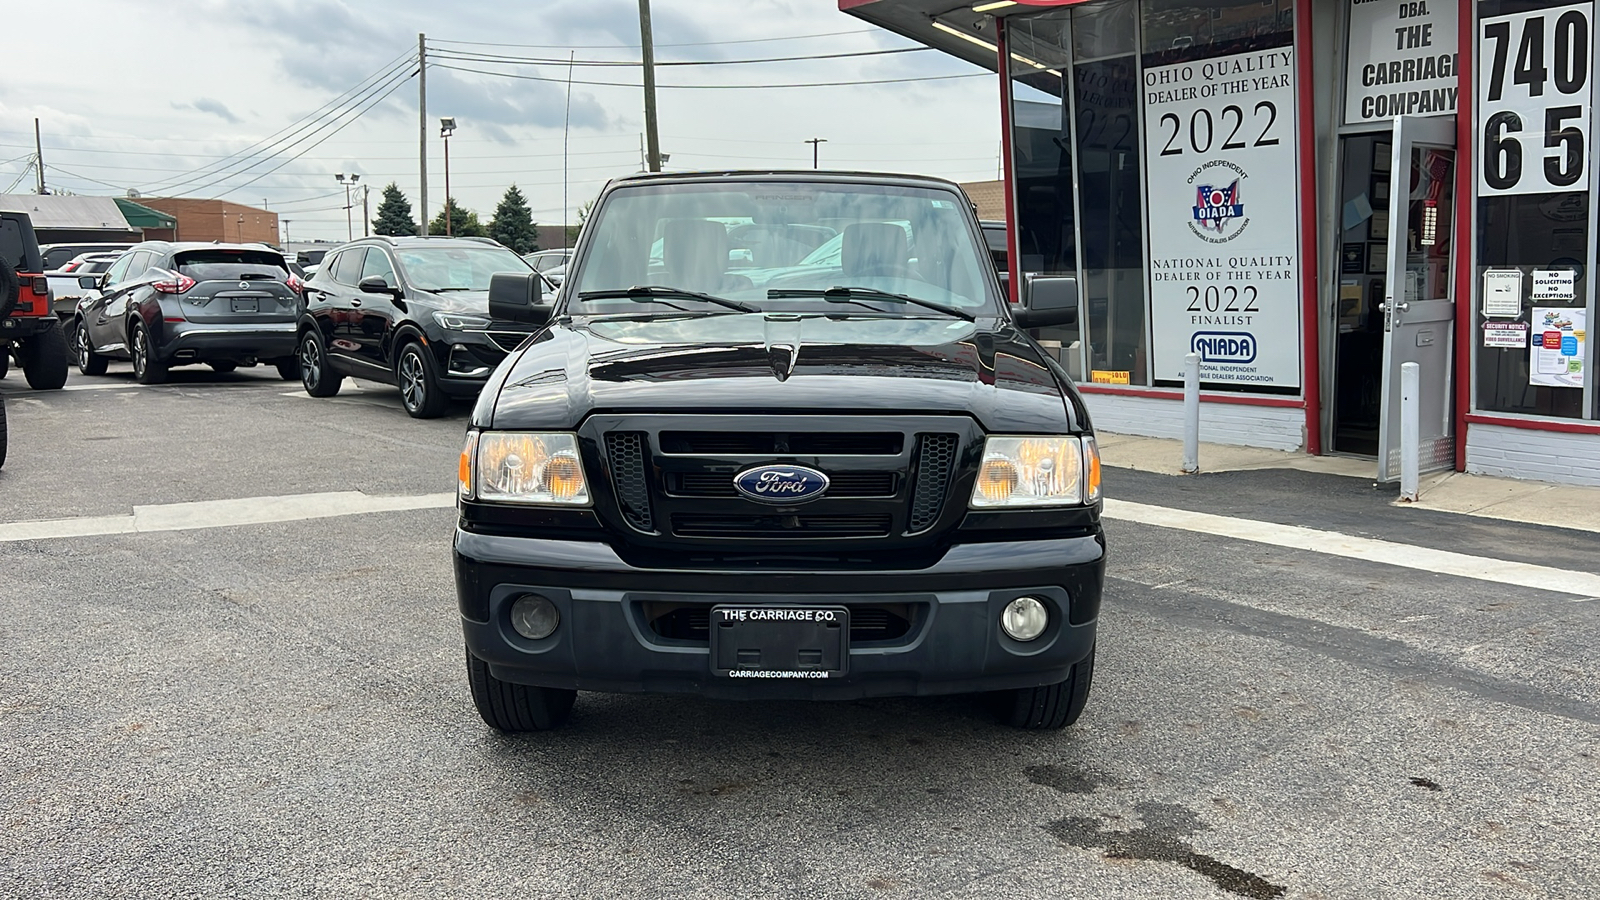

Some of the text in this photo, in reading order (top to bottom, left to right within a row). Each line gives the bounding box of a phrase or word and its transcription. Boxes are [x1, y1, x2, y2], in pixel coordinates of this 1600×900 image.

[1399, 1, 1430, 19] DBA.
[1395, 23, 1433, 50] THE
[1484, 9, 1588, 102] 740
[1146, 66, 1193, 86] OHIO
[1202, 51, 1292, 80] QUALITY
[1148, 87, 1198, 104] DEALER
[1201, 84, 1218, 98] OF
[1221, 79, 1248, 95] THE
[1252, 73, 1290, 91] YEAR
[1361, 87, 1458, 119] COMPANY
[1159, 100, 1280, 157] 2022
[1187, 159, 1249, 184] OHIO INDEPENDENT
[1198, 206, 1235, 219] OIADA
[1153, 256, 1294, 269] NATIONAL QUALITY
[1155, 270, 1292, 281] DEALER OF THE YEAR
[1186, 285, 1259, 312] 2022
[1191, 315, 1253, 325] FINALIST
[1196, 338, 1250, 357] NIADA
[755, 471, 808, 492] Ford
[722, 610, 837, 621] THE CARRIAGE CO.
[729, 670, 829, 679] CARRIAGECOMPANY.COM
